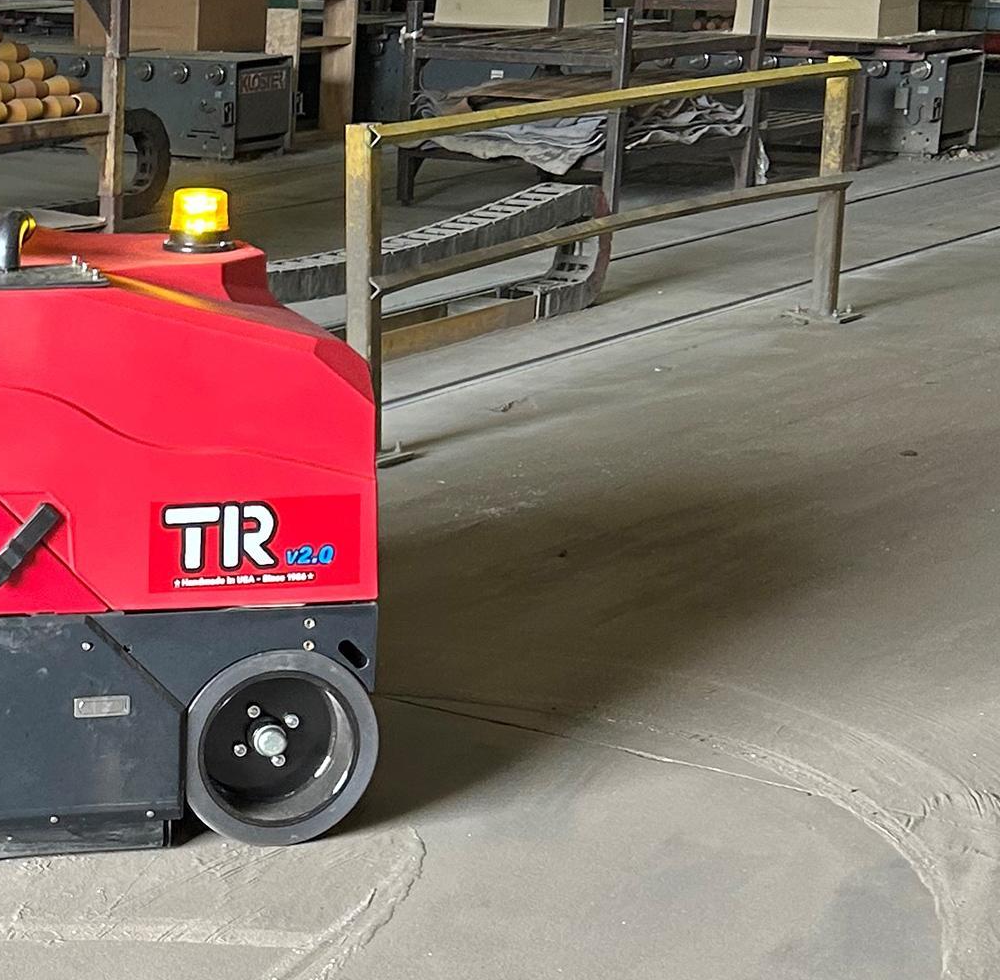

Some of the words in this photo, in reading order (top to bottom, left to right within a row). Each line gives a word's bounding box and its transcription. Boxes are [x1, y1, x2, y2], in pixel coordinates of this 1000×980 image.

[285, 545, 334, 565] v2.0
[226, 575, 235, 584] in
[237, 574, 255, 584] USA
